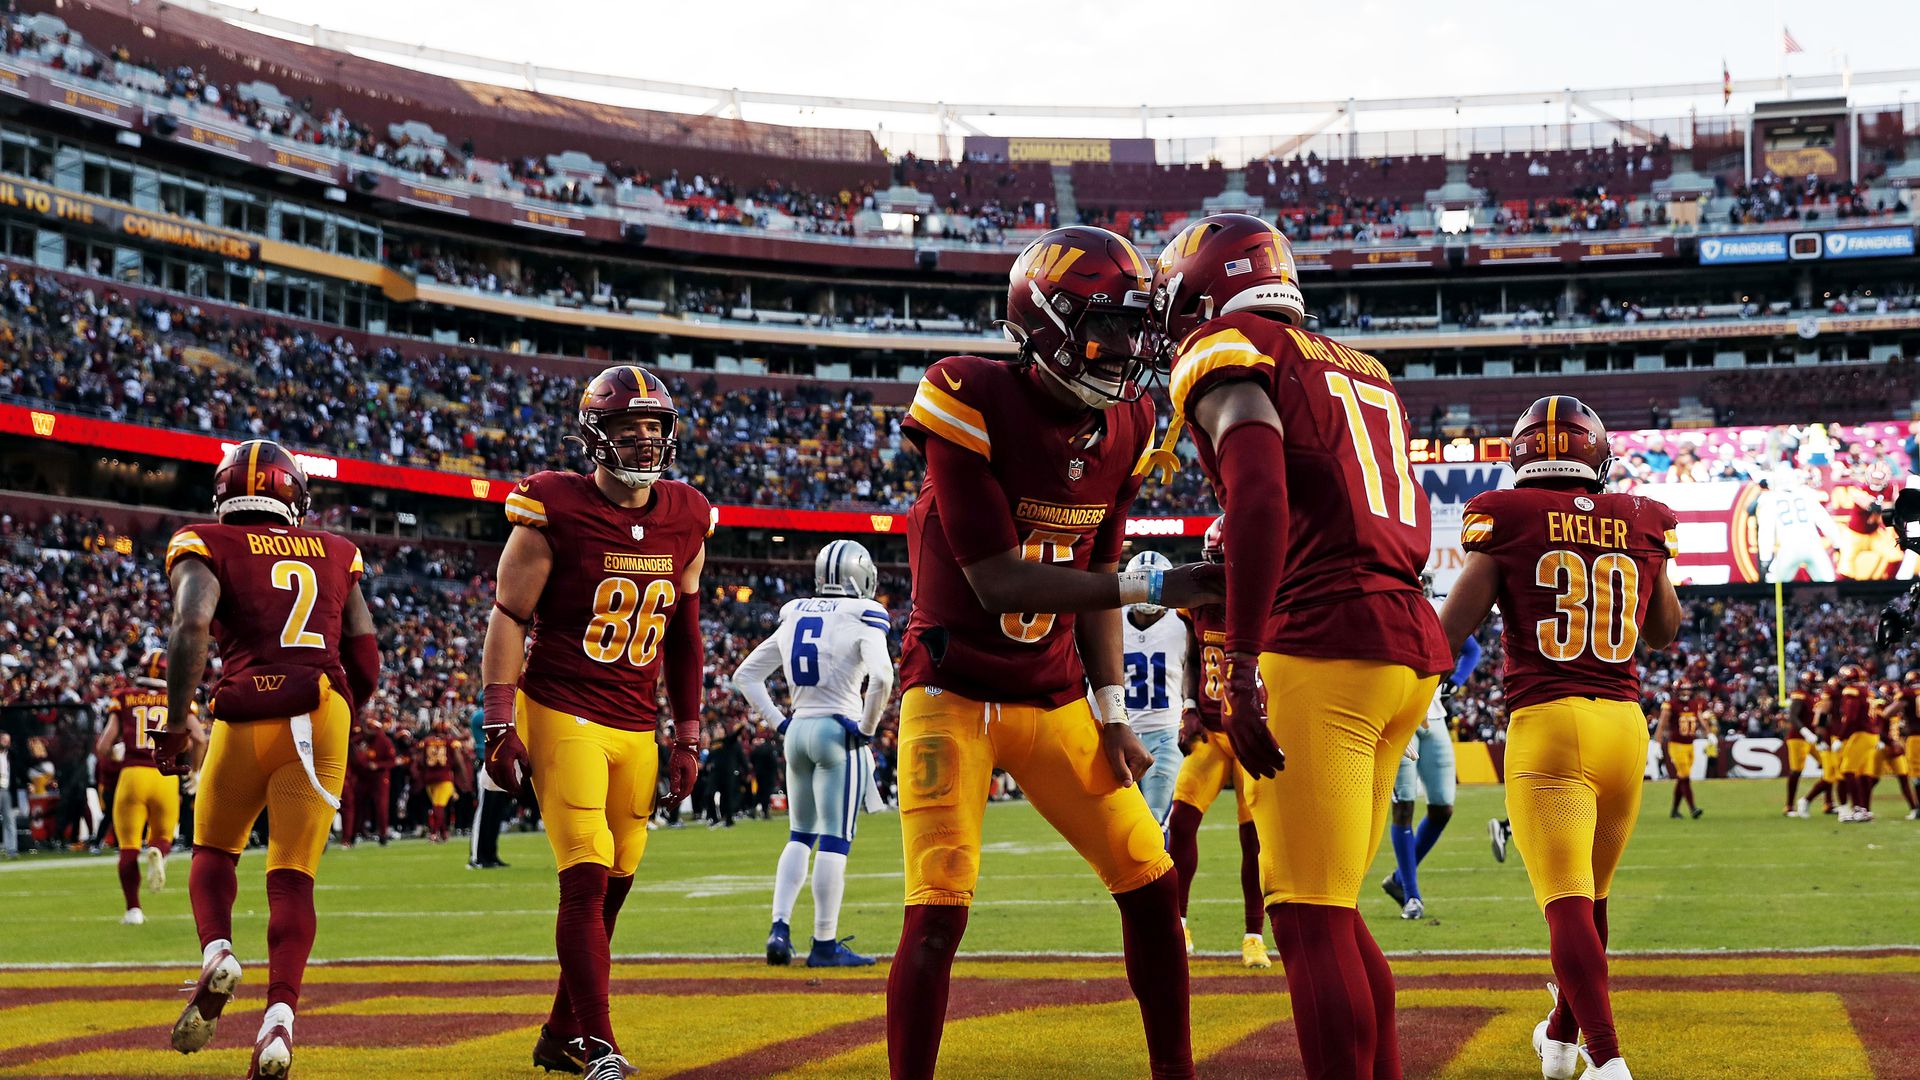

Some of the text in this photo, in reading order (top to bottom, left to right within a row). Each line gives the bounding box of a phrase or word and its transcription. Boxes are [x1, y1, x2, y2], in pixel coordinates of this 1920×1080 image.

[24, 188, 50, 212] TO
[56, 195, 94, 224] THE
[123, 214, 251, 260] COMMANDERS
[1722, 241, 1785, 256] FANDUEL
[1847, 235, 1912, 250] FANDUEL
[1591, 328, 1661, 341] WORLD
[1324, 371, 1417, 528] 17
[255, 471, 266, 491] 2
[1422, 467, 1504, 504] NW
[1016, 501, 1106, 526] COMMANDERS
[1547, 511, 1628, 550] EKELER
[246, 532, 326, 558] BROWN
[603, 555, 674, 572] COMMANDERS
[271, 560, 326, 649] 2
[583, 576, 676, 667] 86
[1535, 550, 1639, 664] 30
[790, 616, 824, 686] 6
[1123, 651, 1170, 709] 31
